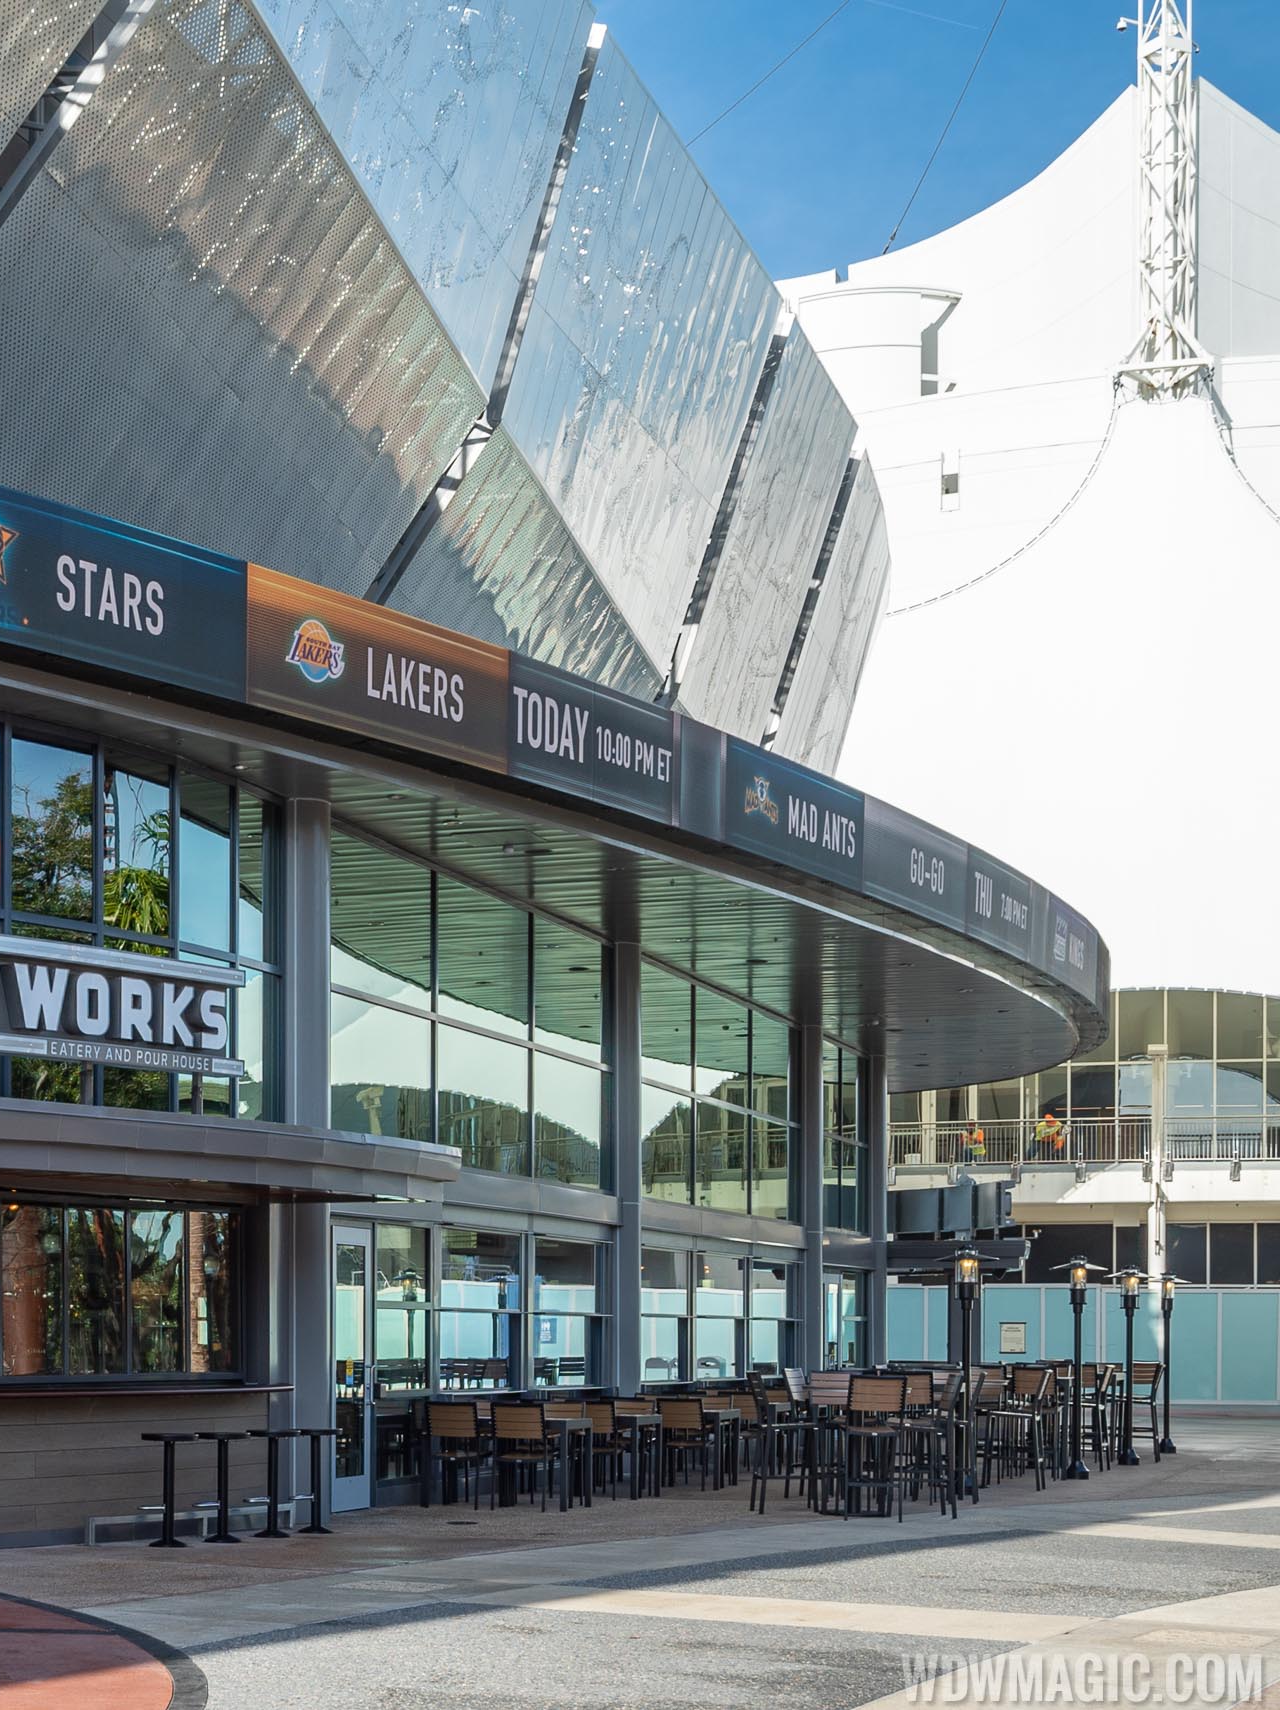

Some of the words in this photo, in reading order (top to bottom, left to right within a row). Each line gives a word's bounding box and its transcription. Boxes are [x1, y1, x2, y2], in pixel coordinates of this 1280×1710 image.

[56, 554, 164, 636] STARS
[287, 632, 341, 676] LAKERS
[367, 646, 464, 723] LAKERS
[513, 686, 589, 764] TODAY
[596, 726, 631, 769] 10:00
[634, 739, 654, 777] PM
[657, 747, 672, 783] ET
[788, 795, 817, 844] MAD
[822, 810, 856, 859] ANTS
[910, 847, 944, 895] GO-GO
[975, 871, 993, 919] THU
[13, 962, 228, 1050] WORKS
[50, 1040, 101, 1059] EATERY
[105, 1047, 131, 1063] AND
[136, 1050, 167, 1067] POUR
[172, 1055, 209, 1071] HOUSE
